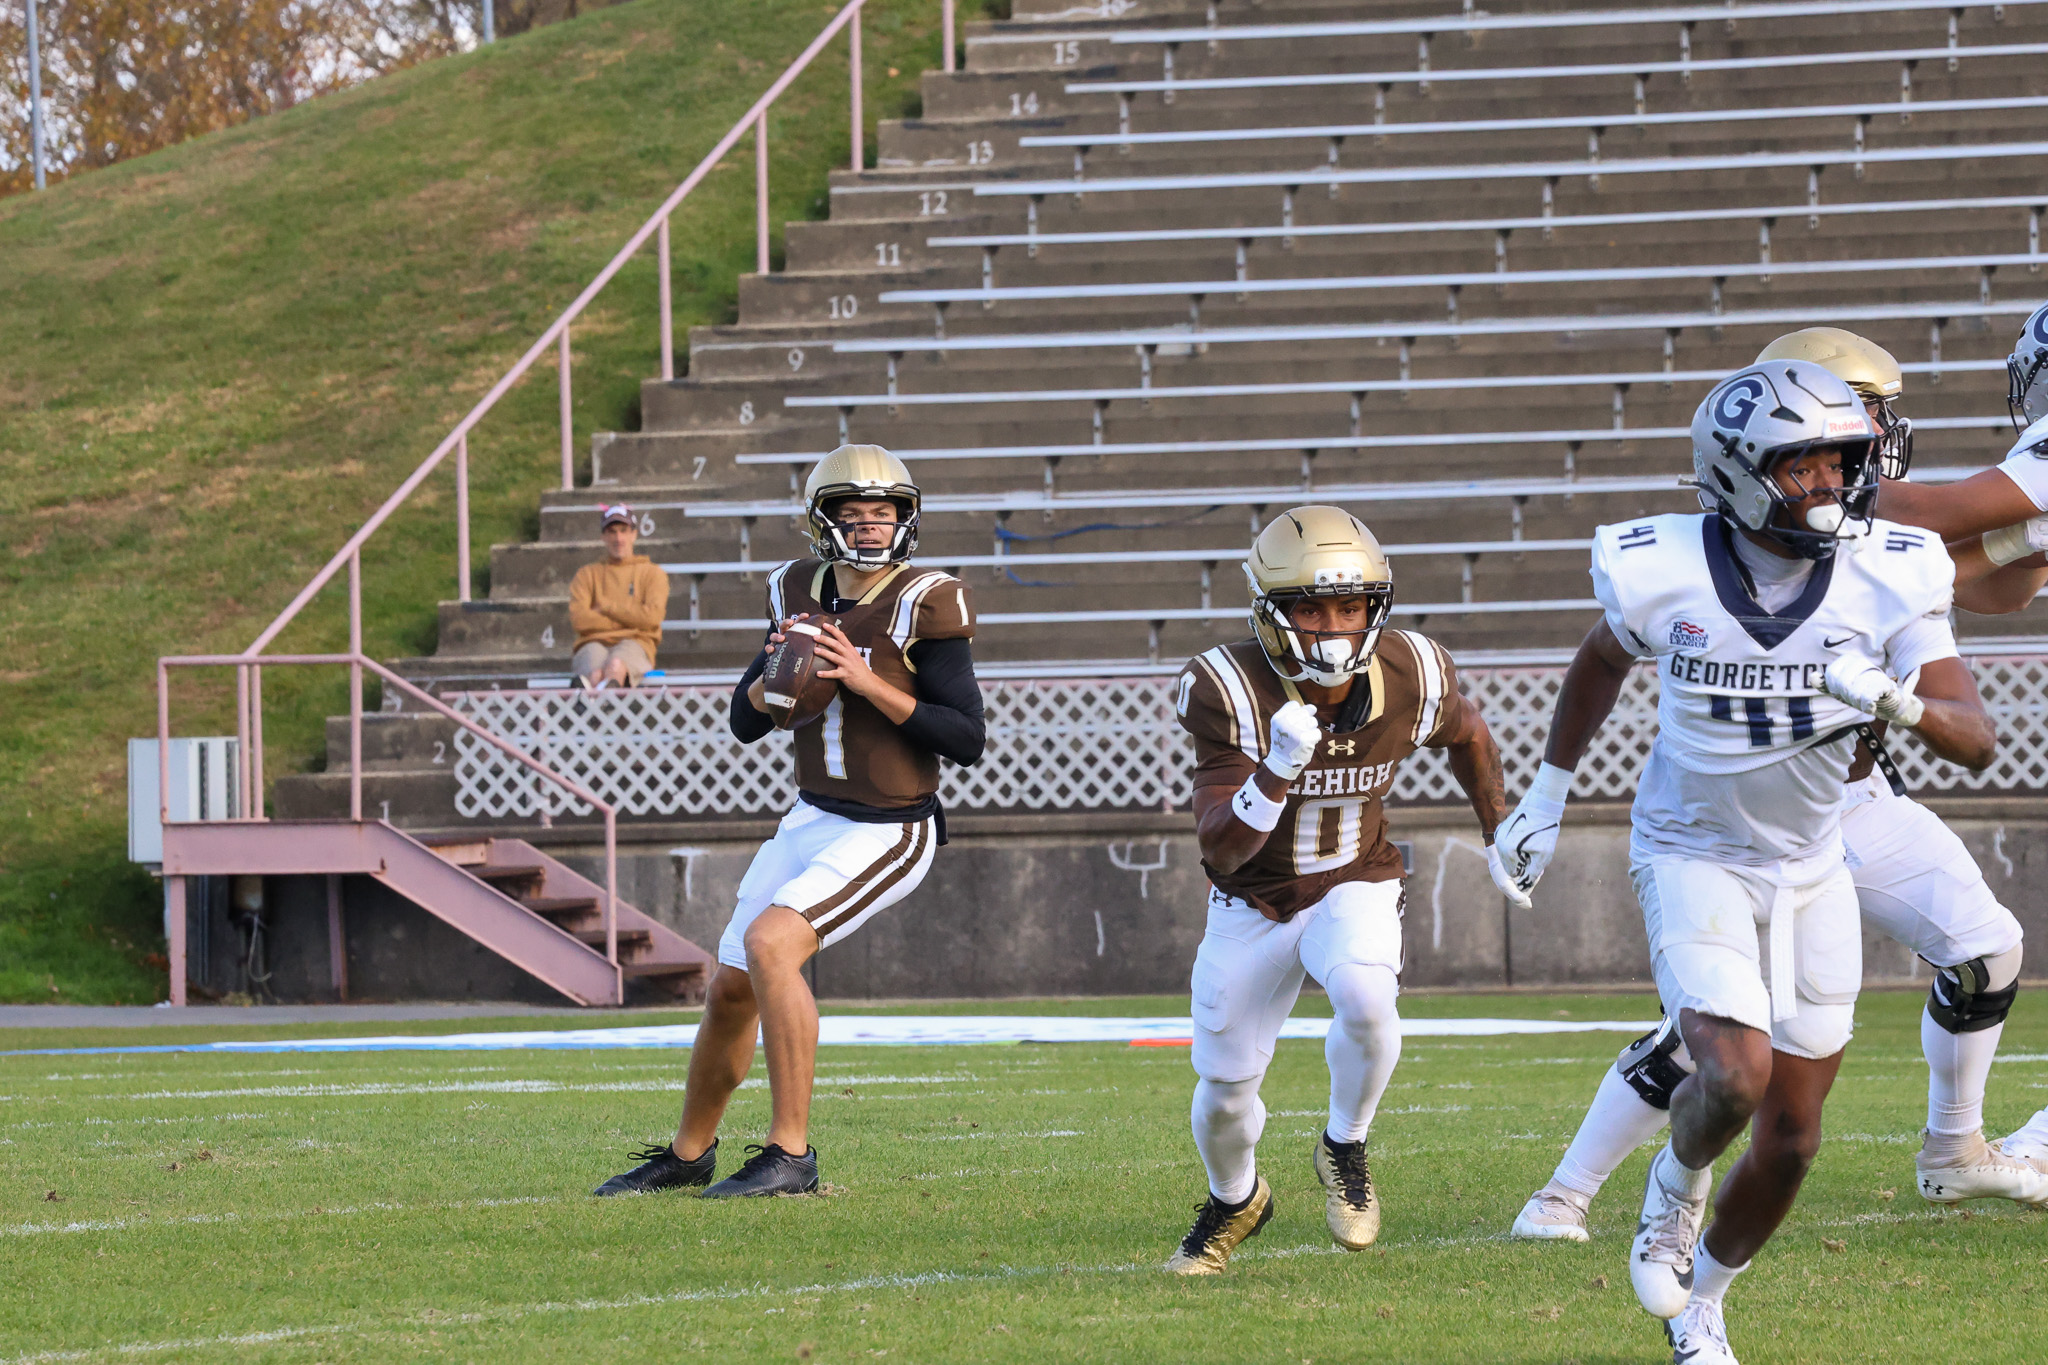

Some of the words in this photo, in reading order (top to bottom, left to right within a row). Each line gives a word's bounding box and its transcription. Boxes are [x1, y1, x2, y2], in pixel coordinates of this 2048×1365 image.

[1053, 41, 1080, 65] 15
[1009, 92, 1039, 116] 14
[967, 140, 994, 164] 13
[919, 191, 948, 216] 12
[875, 242, 900, 266] 11
[828, 294, 858, 319] 10
[788, 349, 804, 372] 9
[739, 401, 755, 425] 8
[1713, 377, 1766, 436] G
[1829, 419, 1866, 433] Riddell
[692, 456, 707, 480] 7
[640, 512, 655, 536] 6
[956, 588, 969, 627] 1
[541, 624, 556, 649] 4
[1669, 632, 1708, 643] PATRIOT
[1669, 638, 1708, 648] LEAGUE
[1670, 653, 1828, 691] GEORGETO
[1176, 670, 1197, 718] 0
[821, 690, 848, 781] 1
[431, 741, 446, 764] 2
[379, 800, 391, 824] 1
[1292, 795, 1371, 876] 0
